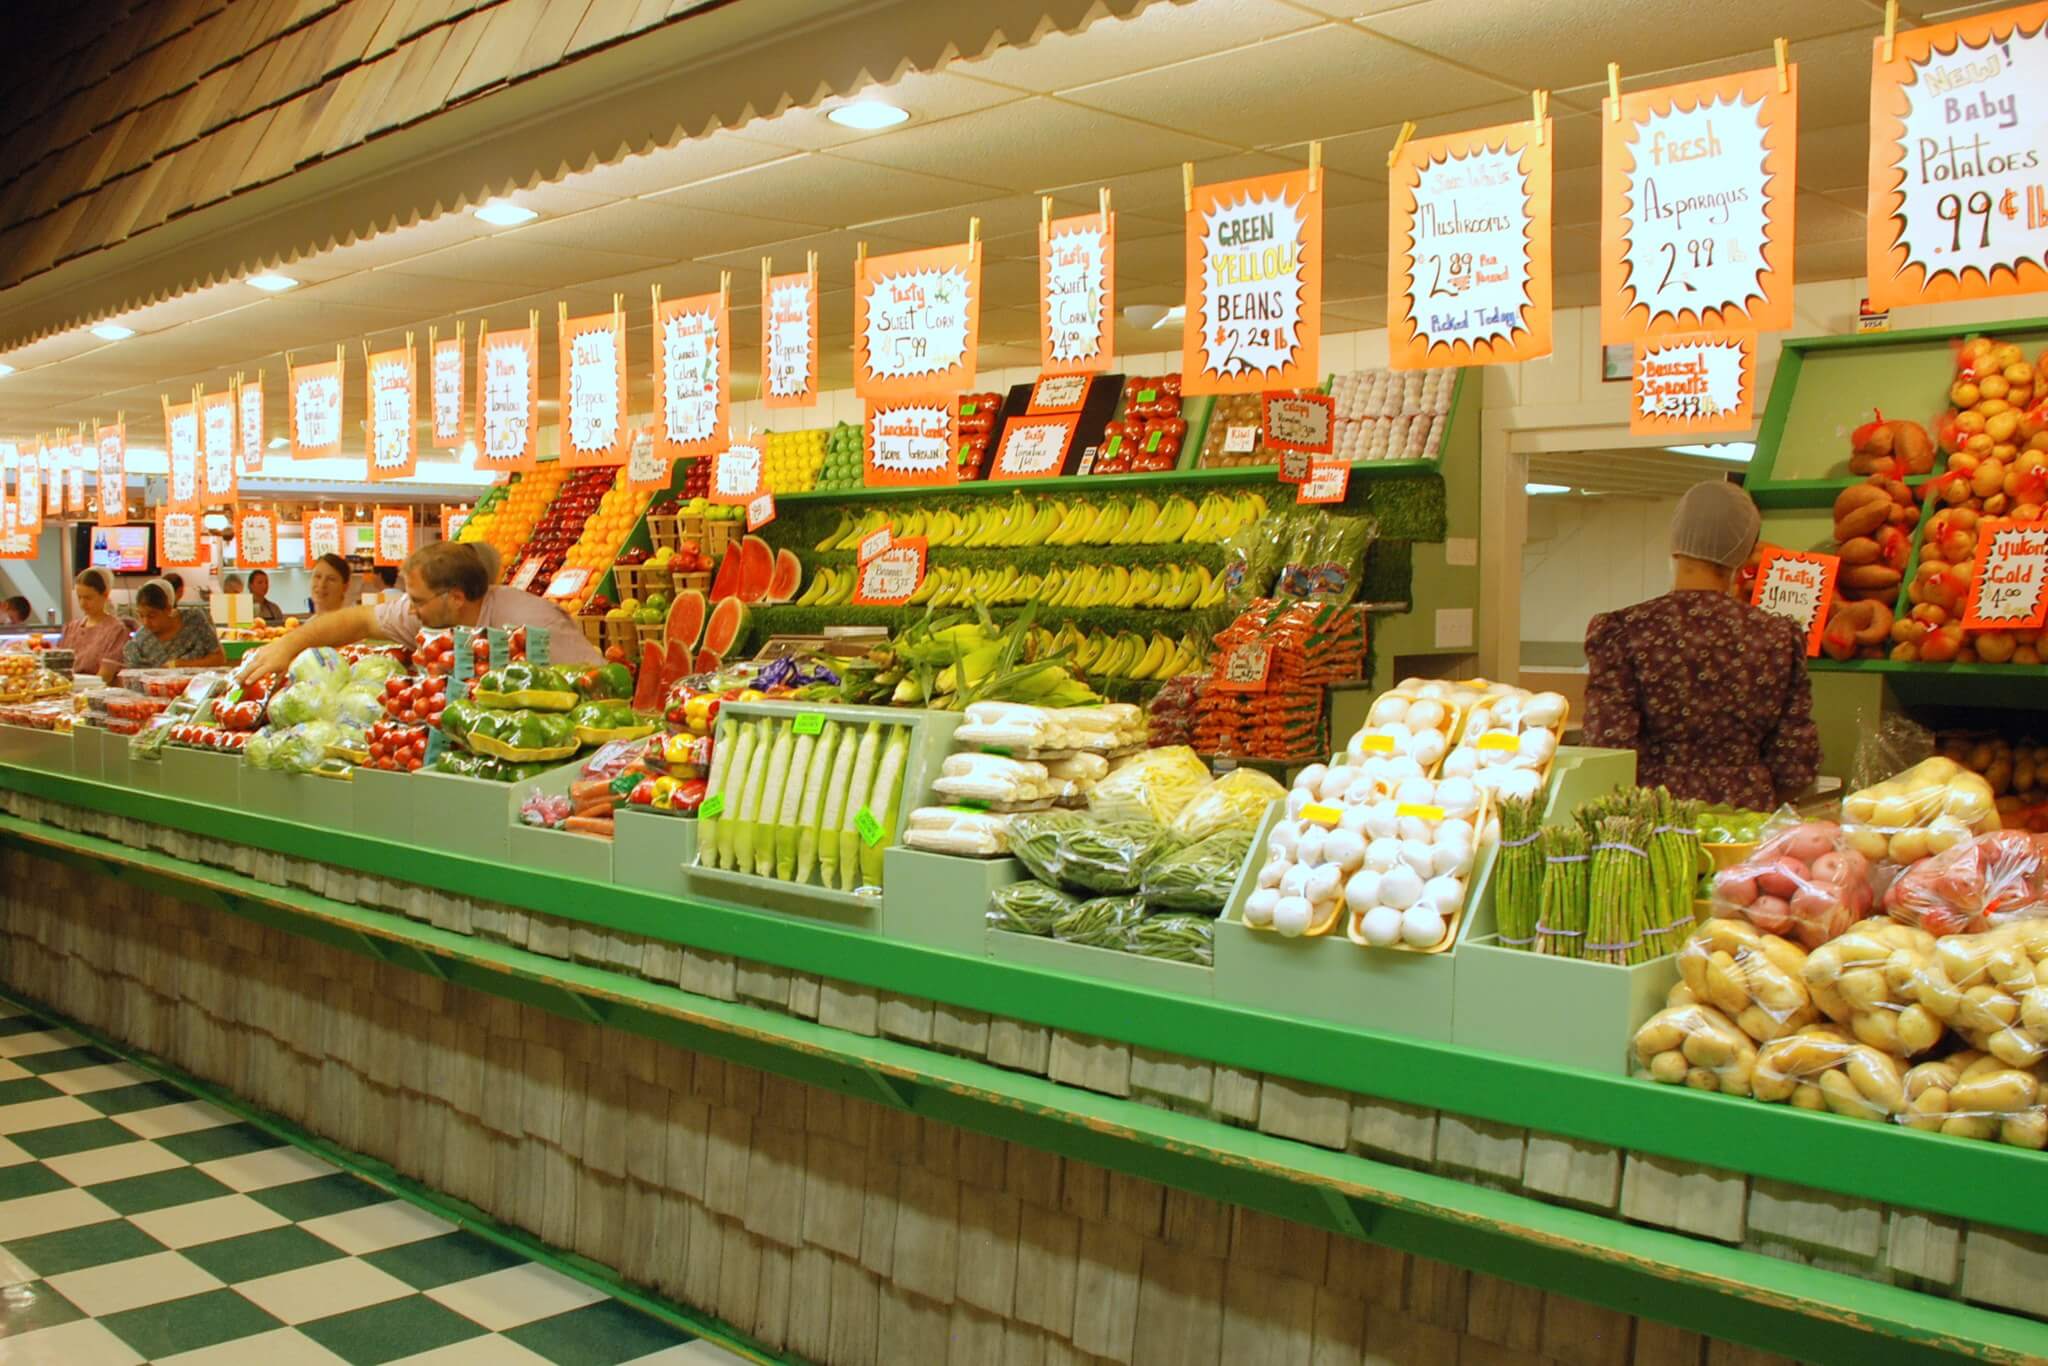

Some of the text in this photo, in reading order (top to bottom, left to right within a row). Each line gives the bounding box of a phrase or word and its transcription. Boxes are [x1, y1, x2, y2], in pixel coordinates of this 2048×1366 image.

[1944, 90, 2018, 129] Baby
[1420, 199, 1511, 239] Mushrooms
[1643, 177, 1749, 230] Asparagus
[1218, 213, 1275, 247] GREEN
[1211, 240, 1297, 287] YELLOW
[1217, 290, 1285, 323] BEANS
[1987, 563, 2034, 585] Gold
